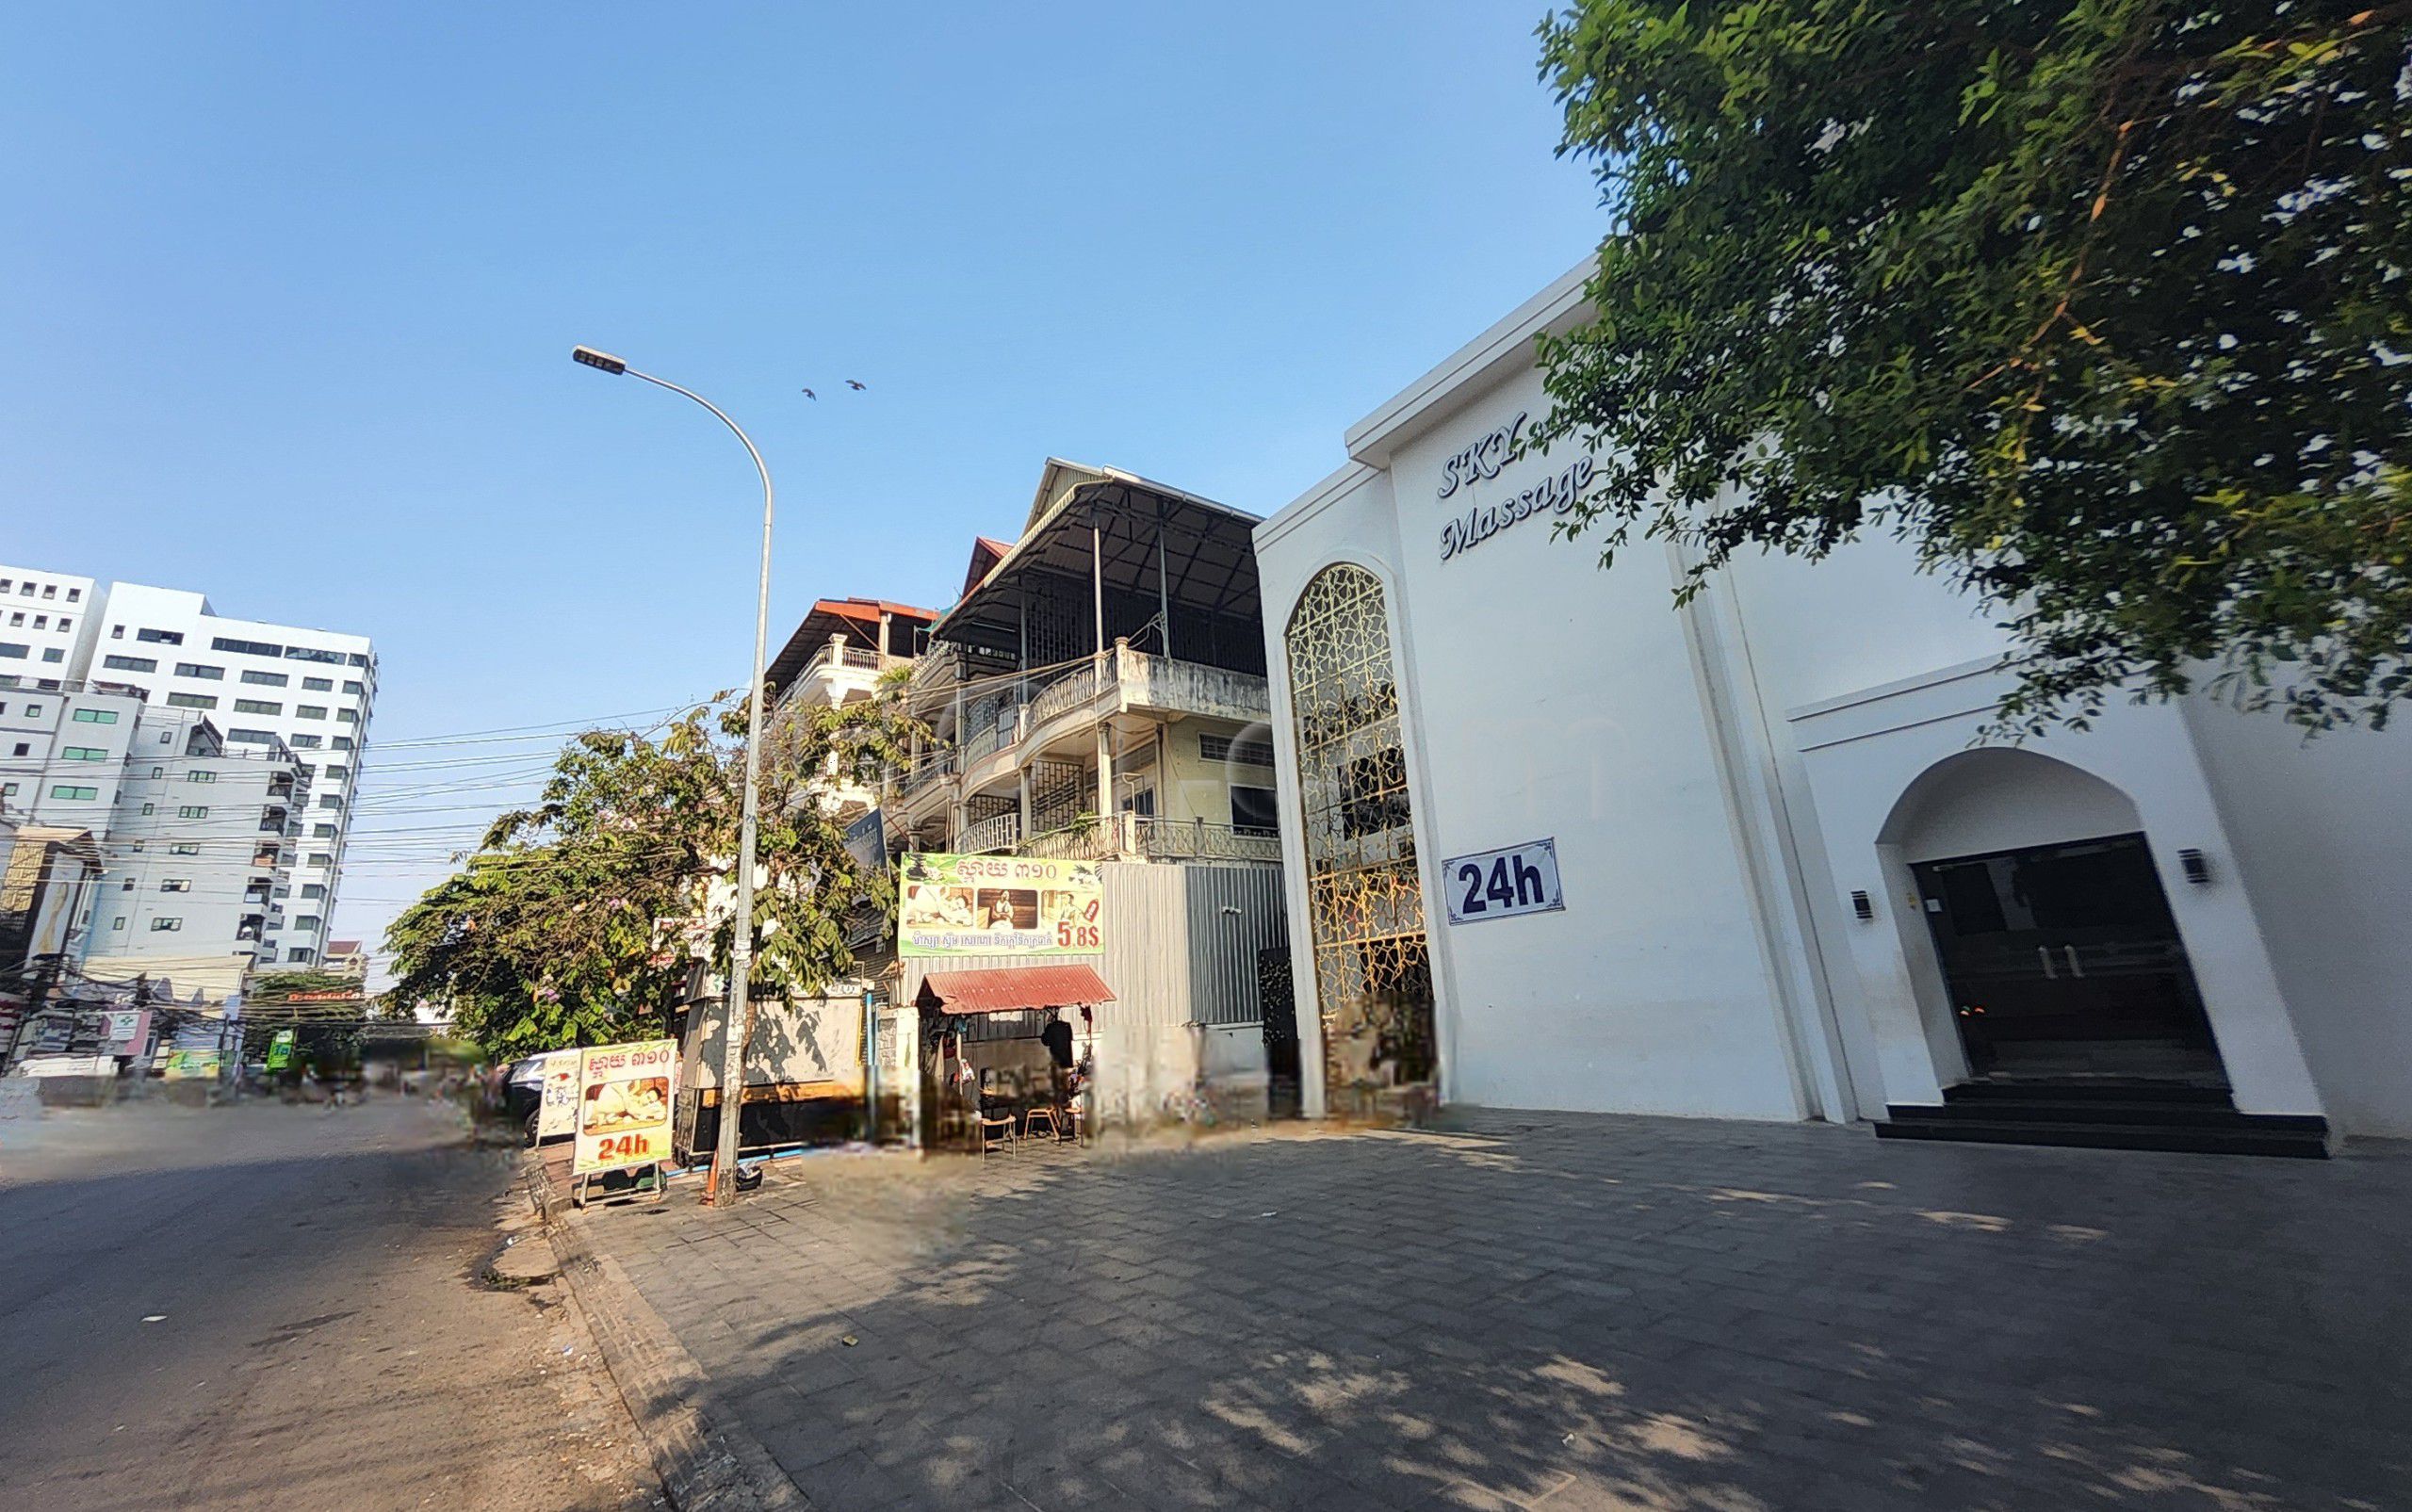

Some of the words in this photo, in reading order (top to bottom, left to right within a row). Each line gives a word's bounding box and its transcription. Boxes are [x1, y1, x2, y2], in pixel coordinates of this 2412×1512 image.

[1438, 411, 1527, 499] SKY
[1440, 455, 1594, 561] Massage
[1458, 854, 1545, 915] 24h
[597, 1133, 650, 1162] 24h
